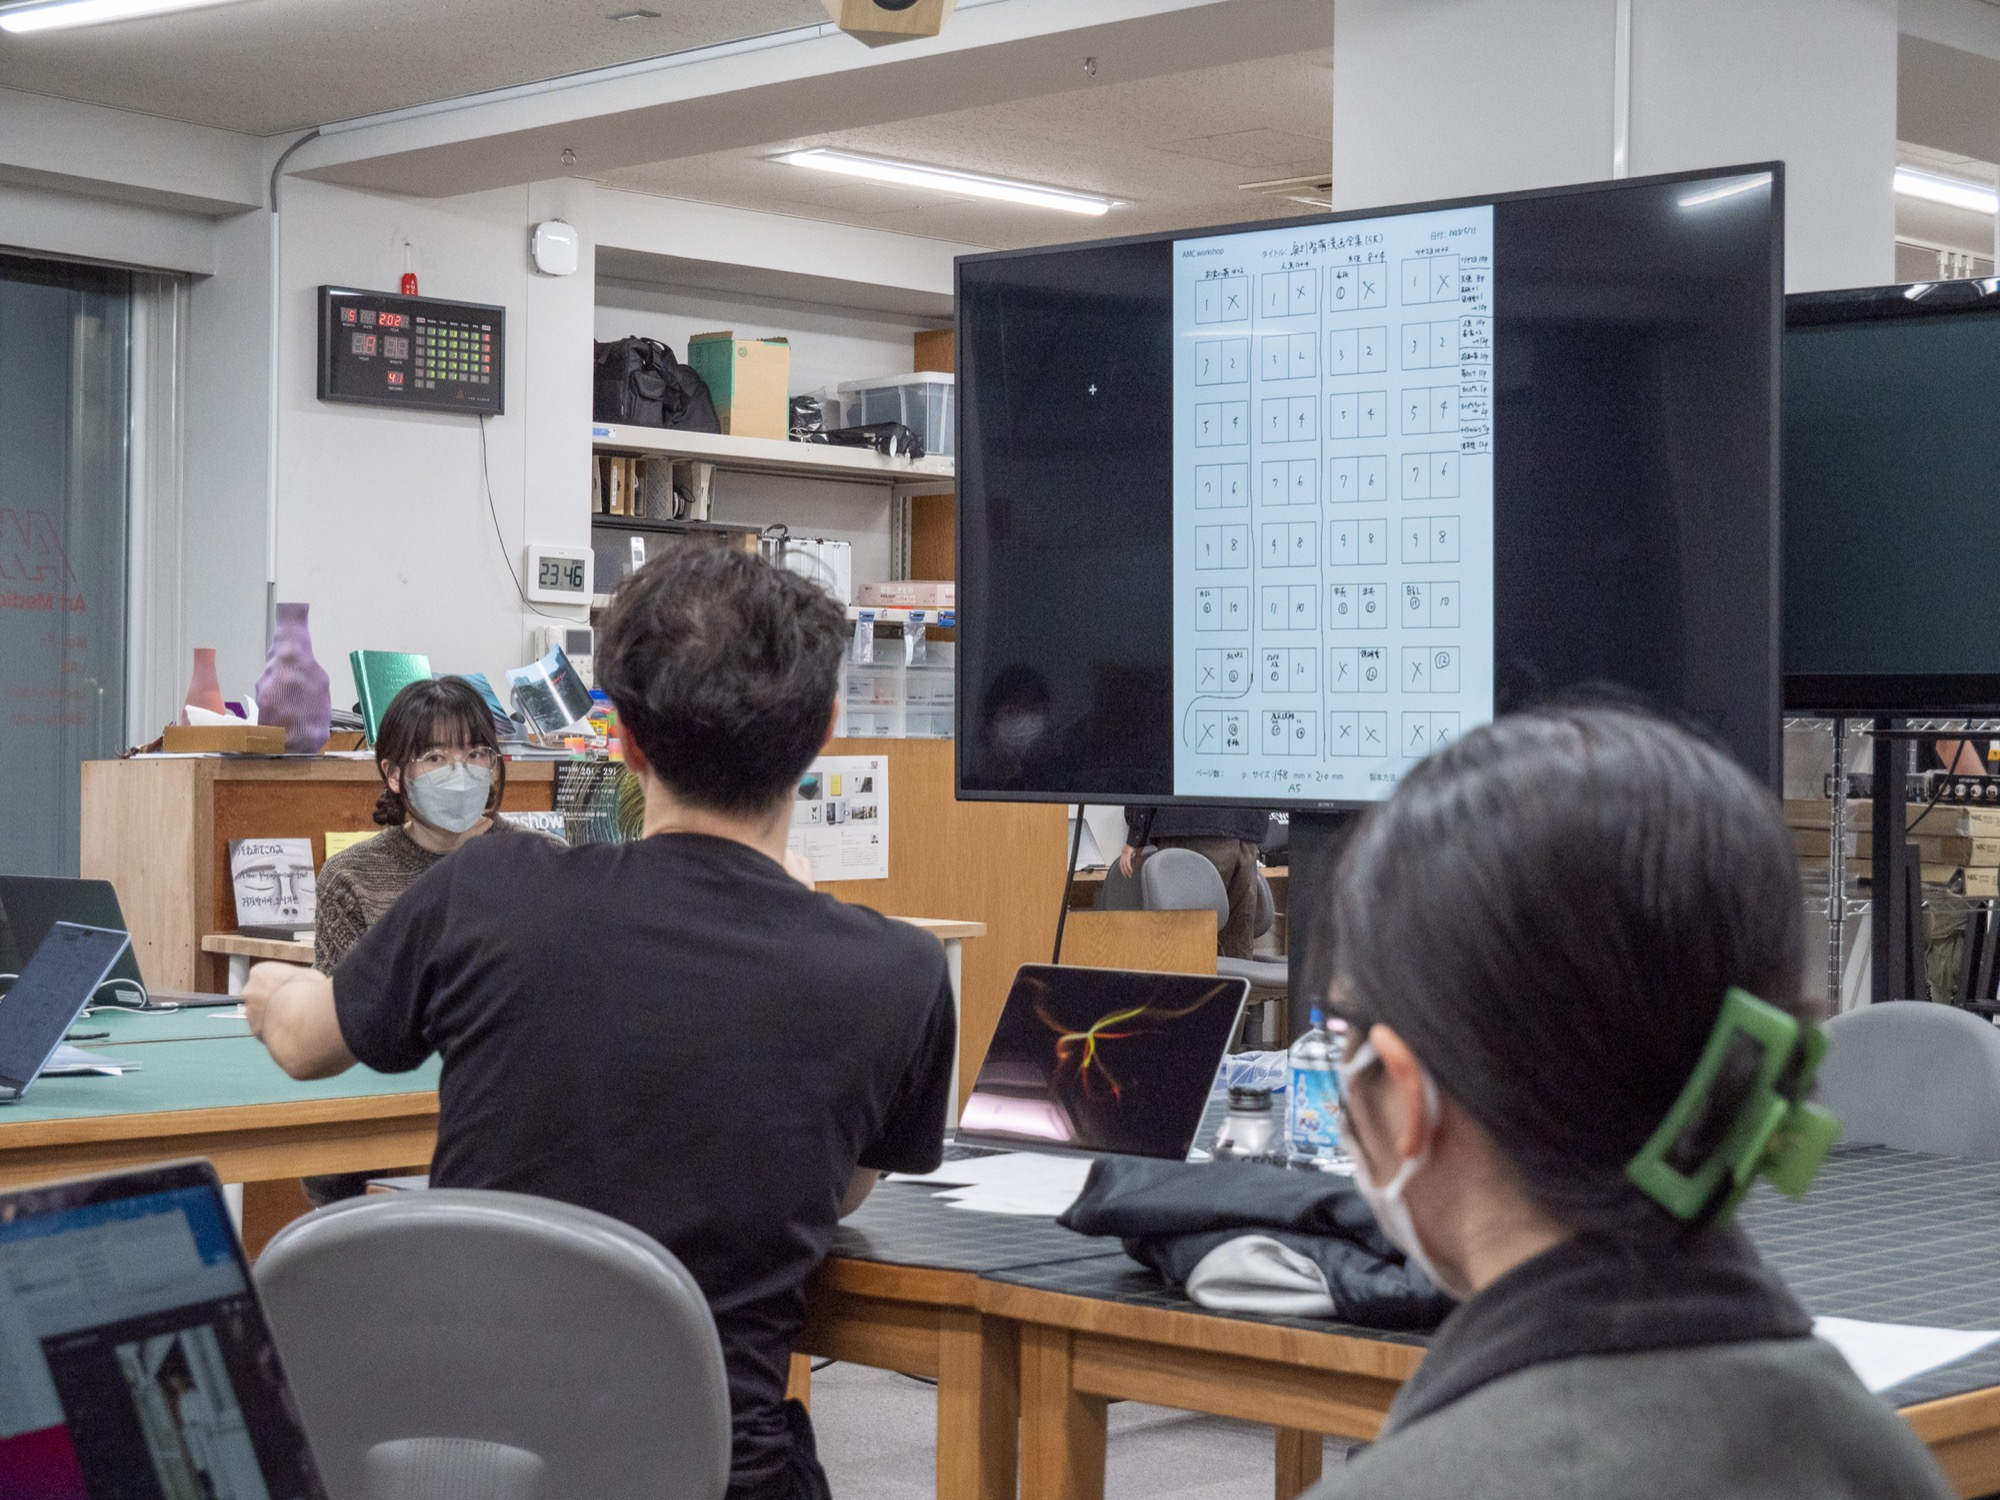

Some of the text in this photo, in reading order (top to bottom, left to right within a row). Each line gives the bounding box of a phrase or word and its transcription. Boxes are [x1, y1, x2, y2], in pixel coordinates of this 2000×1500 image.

[1182, 248, 1224, 258] AMC workshop
[349, 310, 355, 322] 5
[389, 372, 403, 385] 41
[1288, 784, 1301, 793] A5
